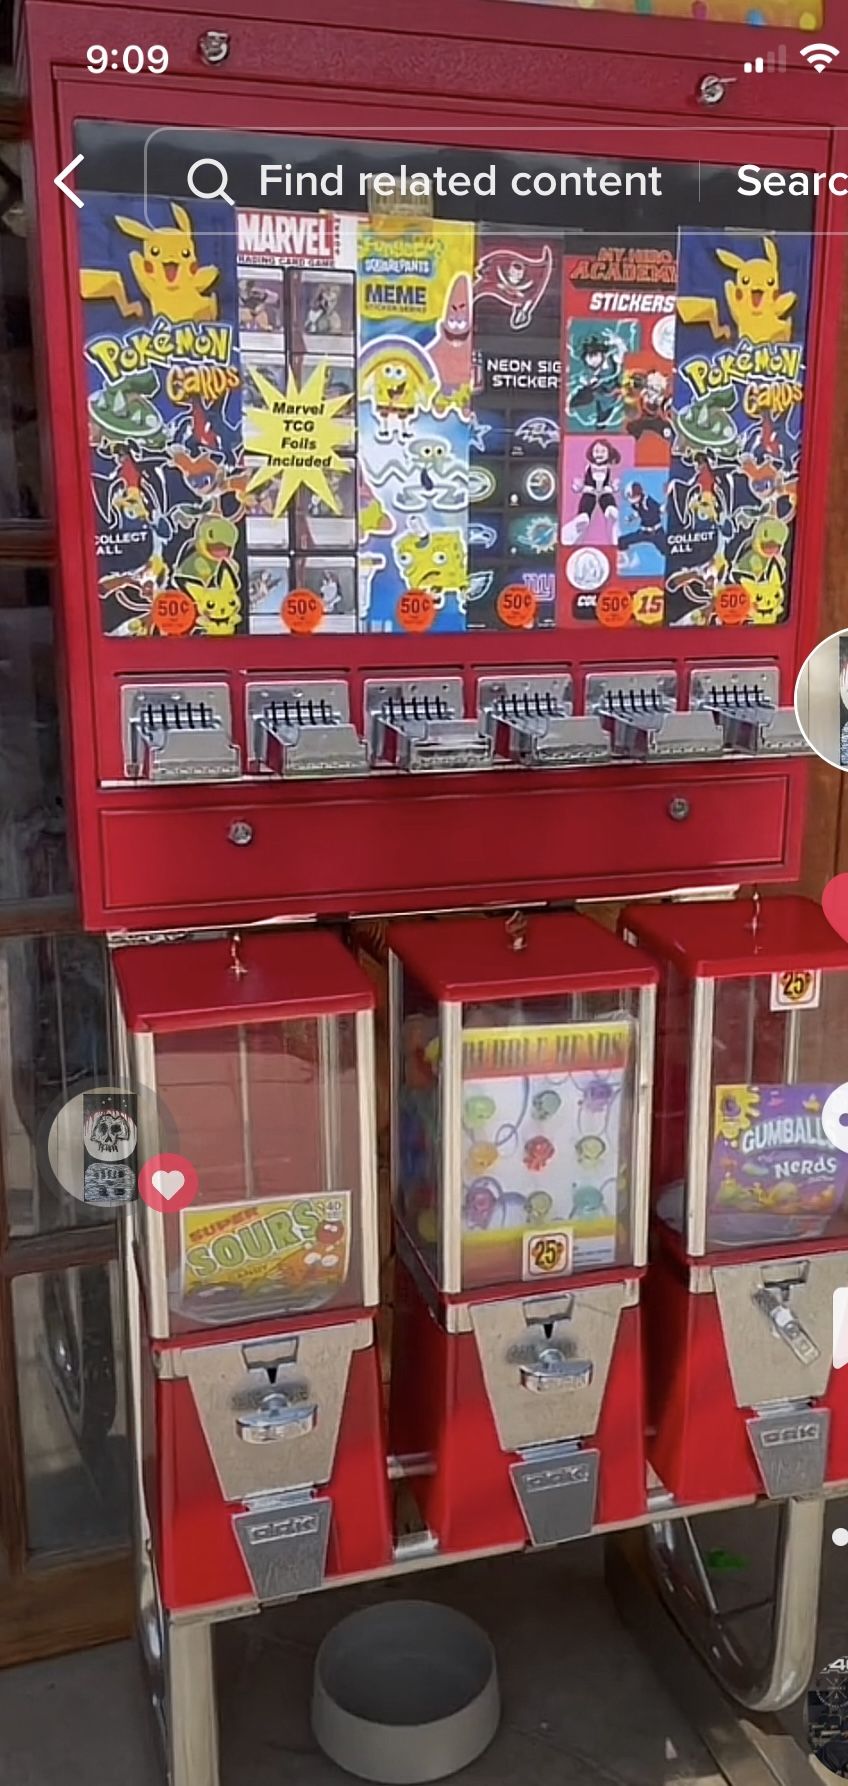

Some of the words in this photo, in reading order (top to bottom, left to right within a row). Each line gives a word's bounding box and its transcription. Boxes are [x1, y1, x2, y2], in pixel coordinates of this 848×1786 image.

[237, 213, 331, 256] MARVEL
[365, 284, 427, 304] MEME
[589, 292, 676, 313] STICKERS
[487, 358, 532, 373] NEON
[492, 374, 560, 389] STICKER
[273, 402, 325, 416] Marvel
[283, 419, 315, 433] TCG
[281, 436, 317, 450] Foils
[267, 454, 333, 468] Included
[667, 531, 715, 544] COLLECT
[670, 545, 693, 554] ALL
[157, 600, 190, 617] 50¢
[287, 599, 317, 616] 50¢
[401, 597, 431, 614] 50¢
[502, 593, 532, 610] 50¢
[601, 596, 630, 613] 50¢
[637, 595, 662, 614] 15
[720, 594, 747, 609] 50¢
[188, 1206, 261, 1243] SUPER
[186, 1199, 322, 1279] SOURS
